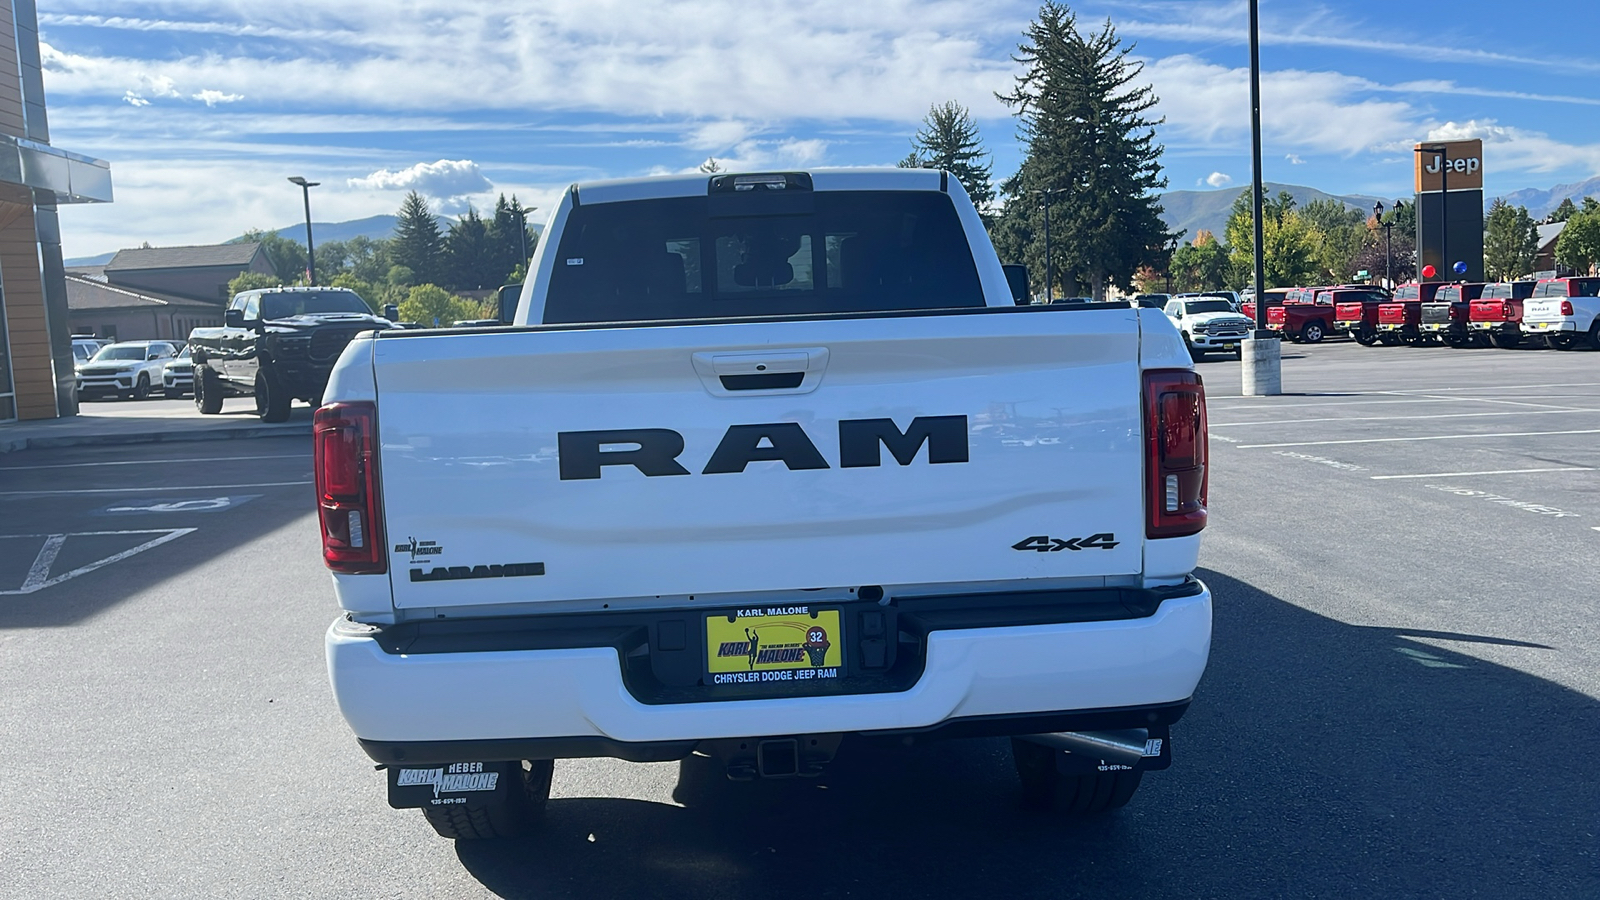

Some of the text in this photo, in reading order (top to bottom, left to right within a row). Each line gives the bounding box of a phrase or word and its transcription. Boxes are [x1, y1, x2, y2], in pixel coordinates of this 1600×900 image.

[1425, 155, 1480, 175] Jeep
[557, 414, 969, 481] RAM
[1011, 533, 1121, 553] 4x4
[737, 606, 809, 618] KARL MALONE
[809, 631, 823, 643] 32
[717, 641, 751, 658] KARL
[756, 648, 805, 664] MALONE
[714, 668, 837, 684] CHRYSLER DODGE JEEP RAM
[448, 762, 483, 774] HEBER
[397, 768, 499, 792] KARL MALONE
